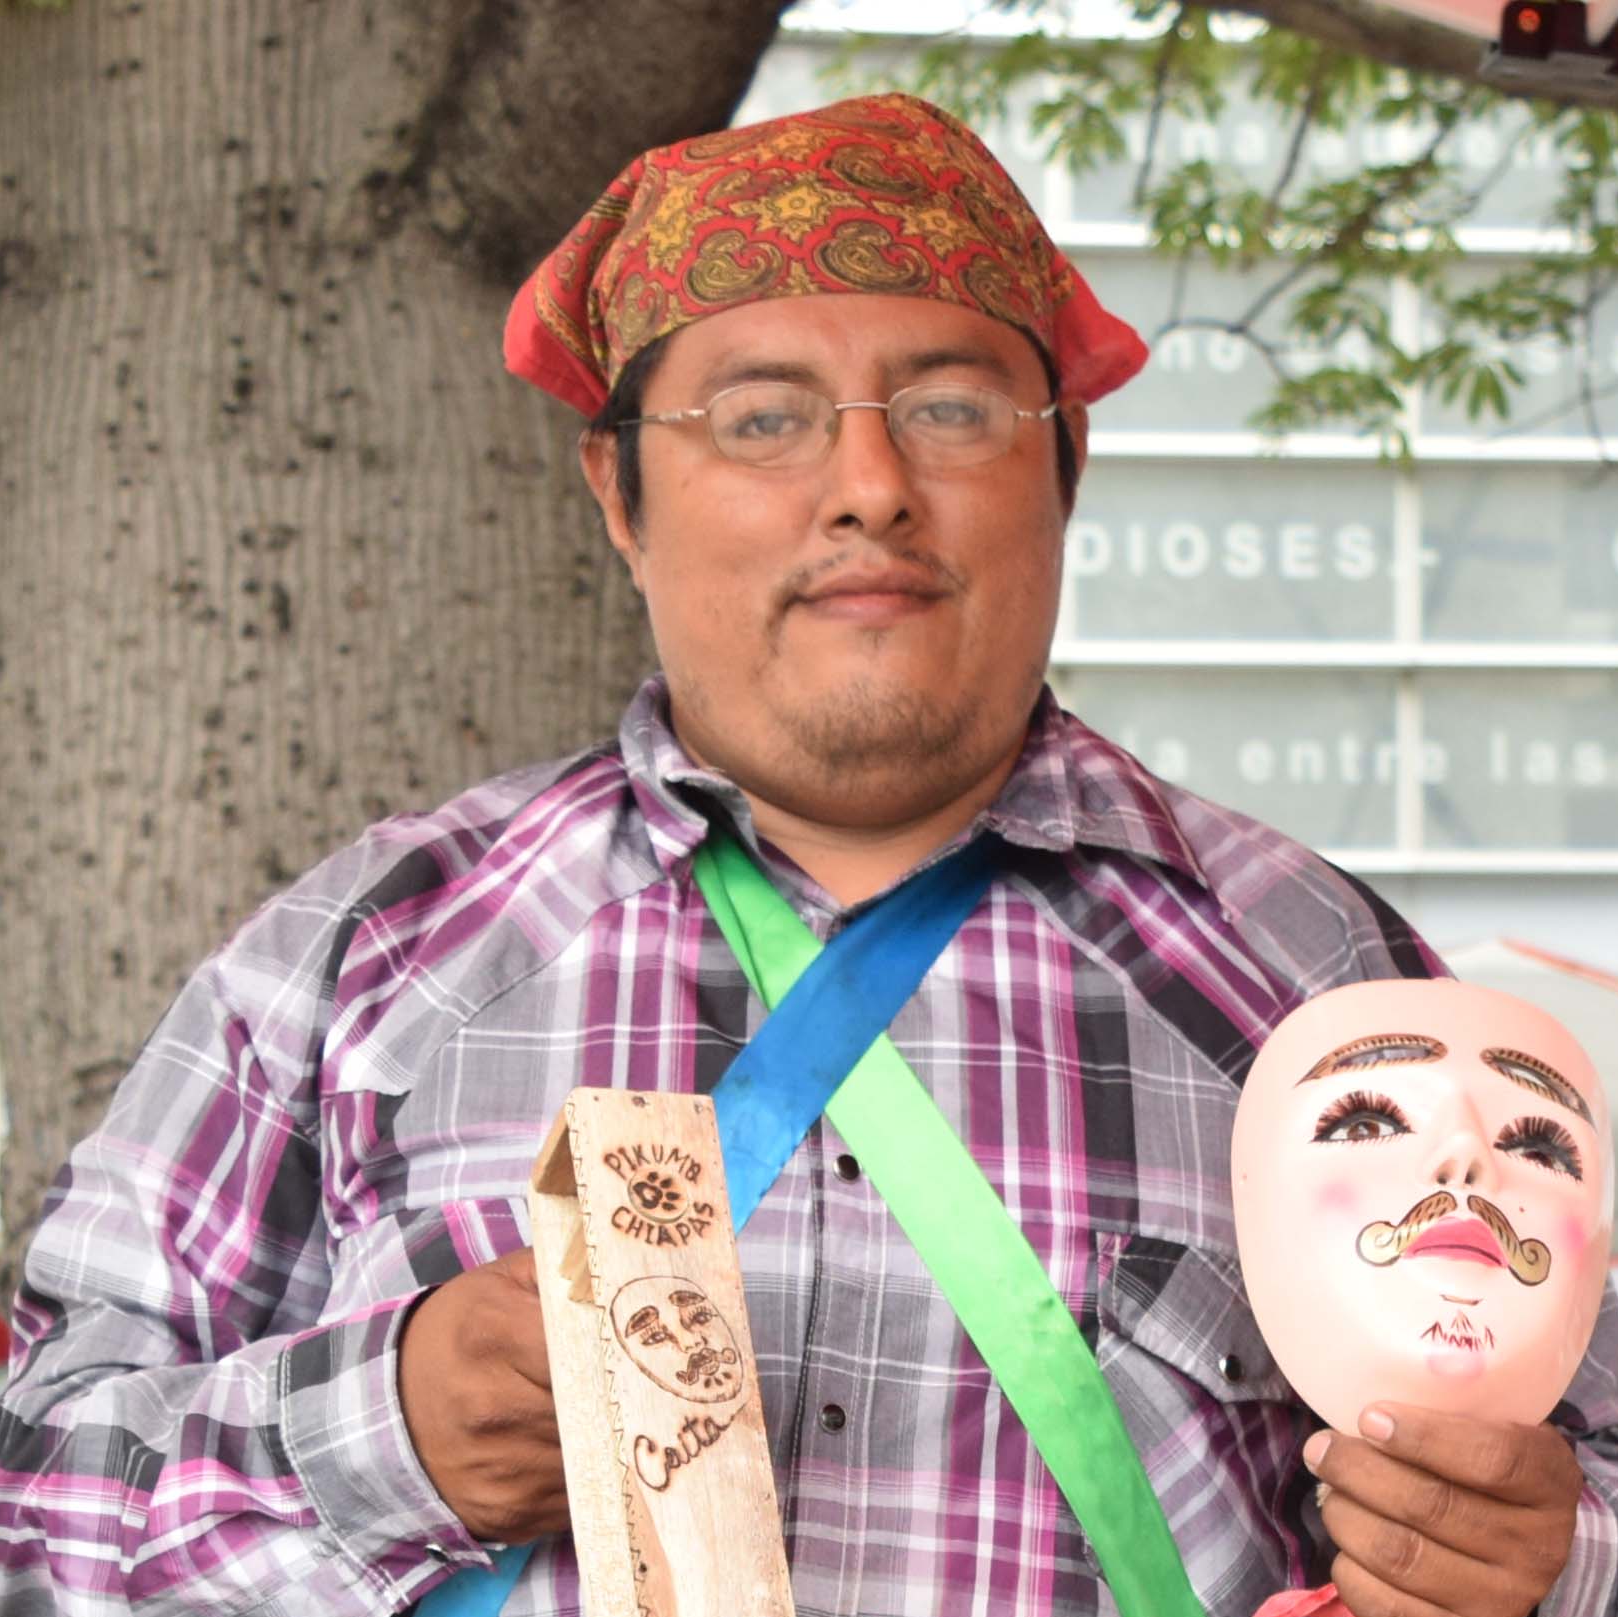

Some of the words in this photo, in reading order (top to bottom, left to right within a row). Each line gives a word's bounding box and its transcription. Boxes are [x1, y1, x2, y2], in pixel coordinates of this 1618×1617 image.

[1237, 730, 1450, 786] entre
[1489, 728, 1609, 786] las
[610, 1201, 715, 1248] CHIAPAS
